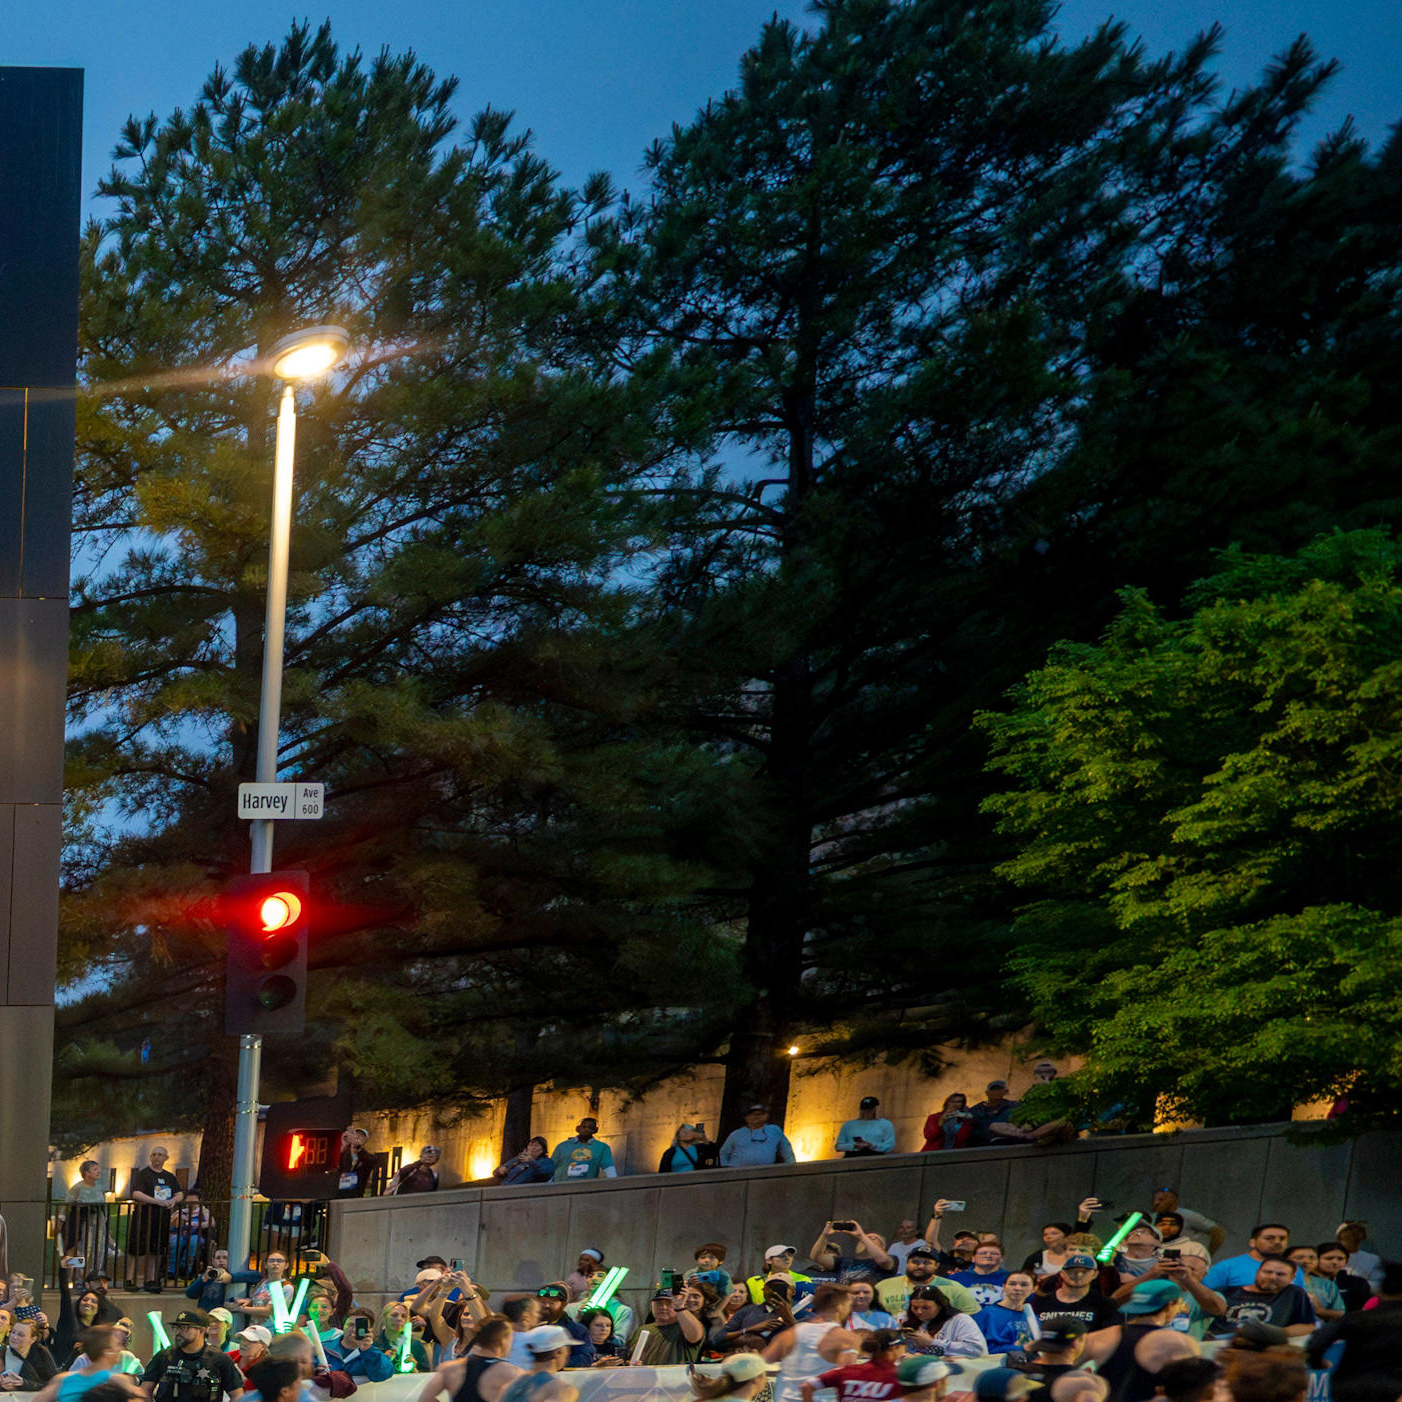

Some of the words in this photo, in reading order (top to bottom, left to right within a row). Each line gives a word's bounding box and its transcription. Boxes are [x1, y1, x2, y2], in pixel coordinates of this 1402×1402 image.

[302, 788, 319, 799] Ave
[242, 793, 288, 814] Harvey
[302, 803, 319, 815] 600
[843, 1380, 895, 1399] TXU
